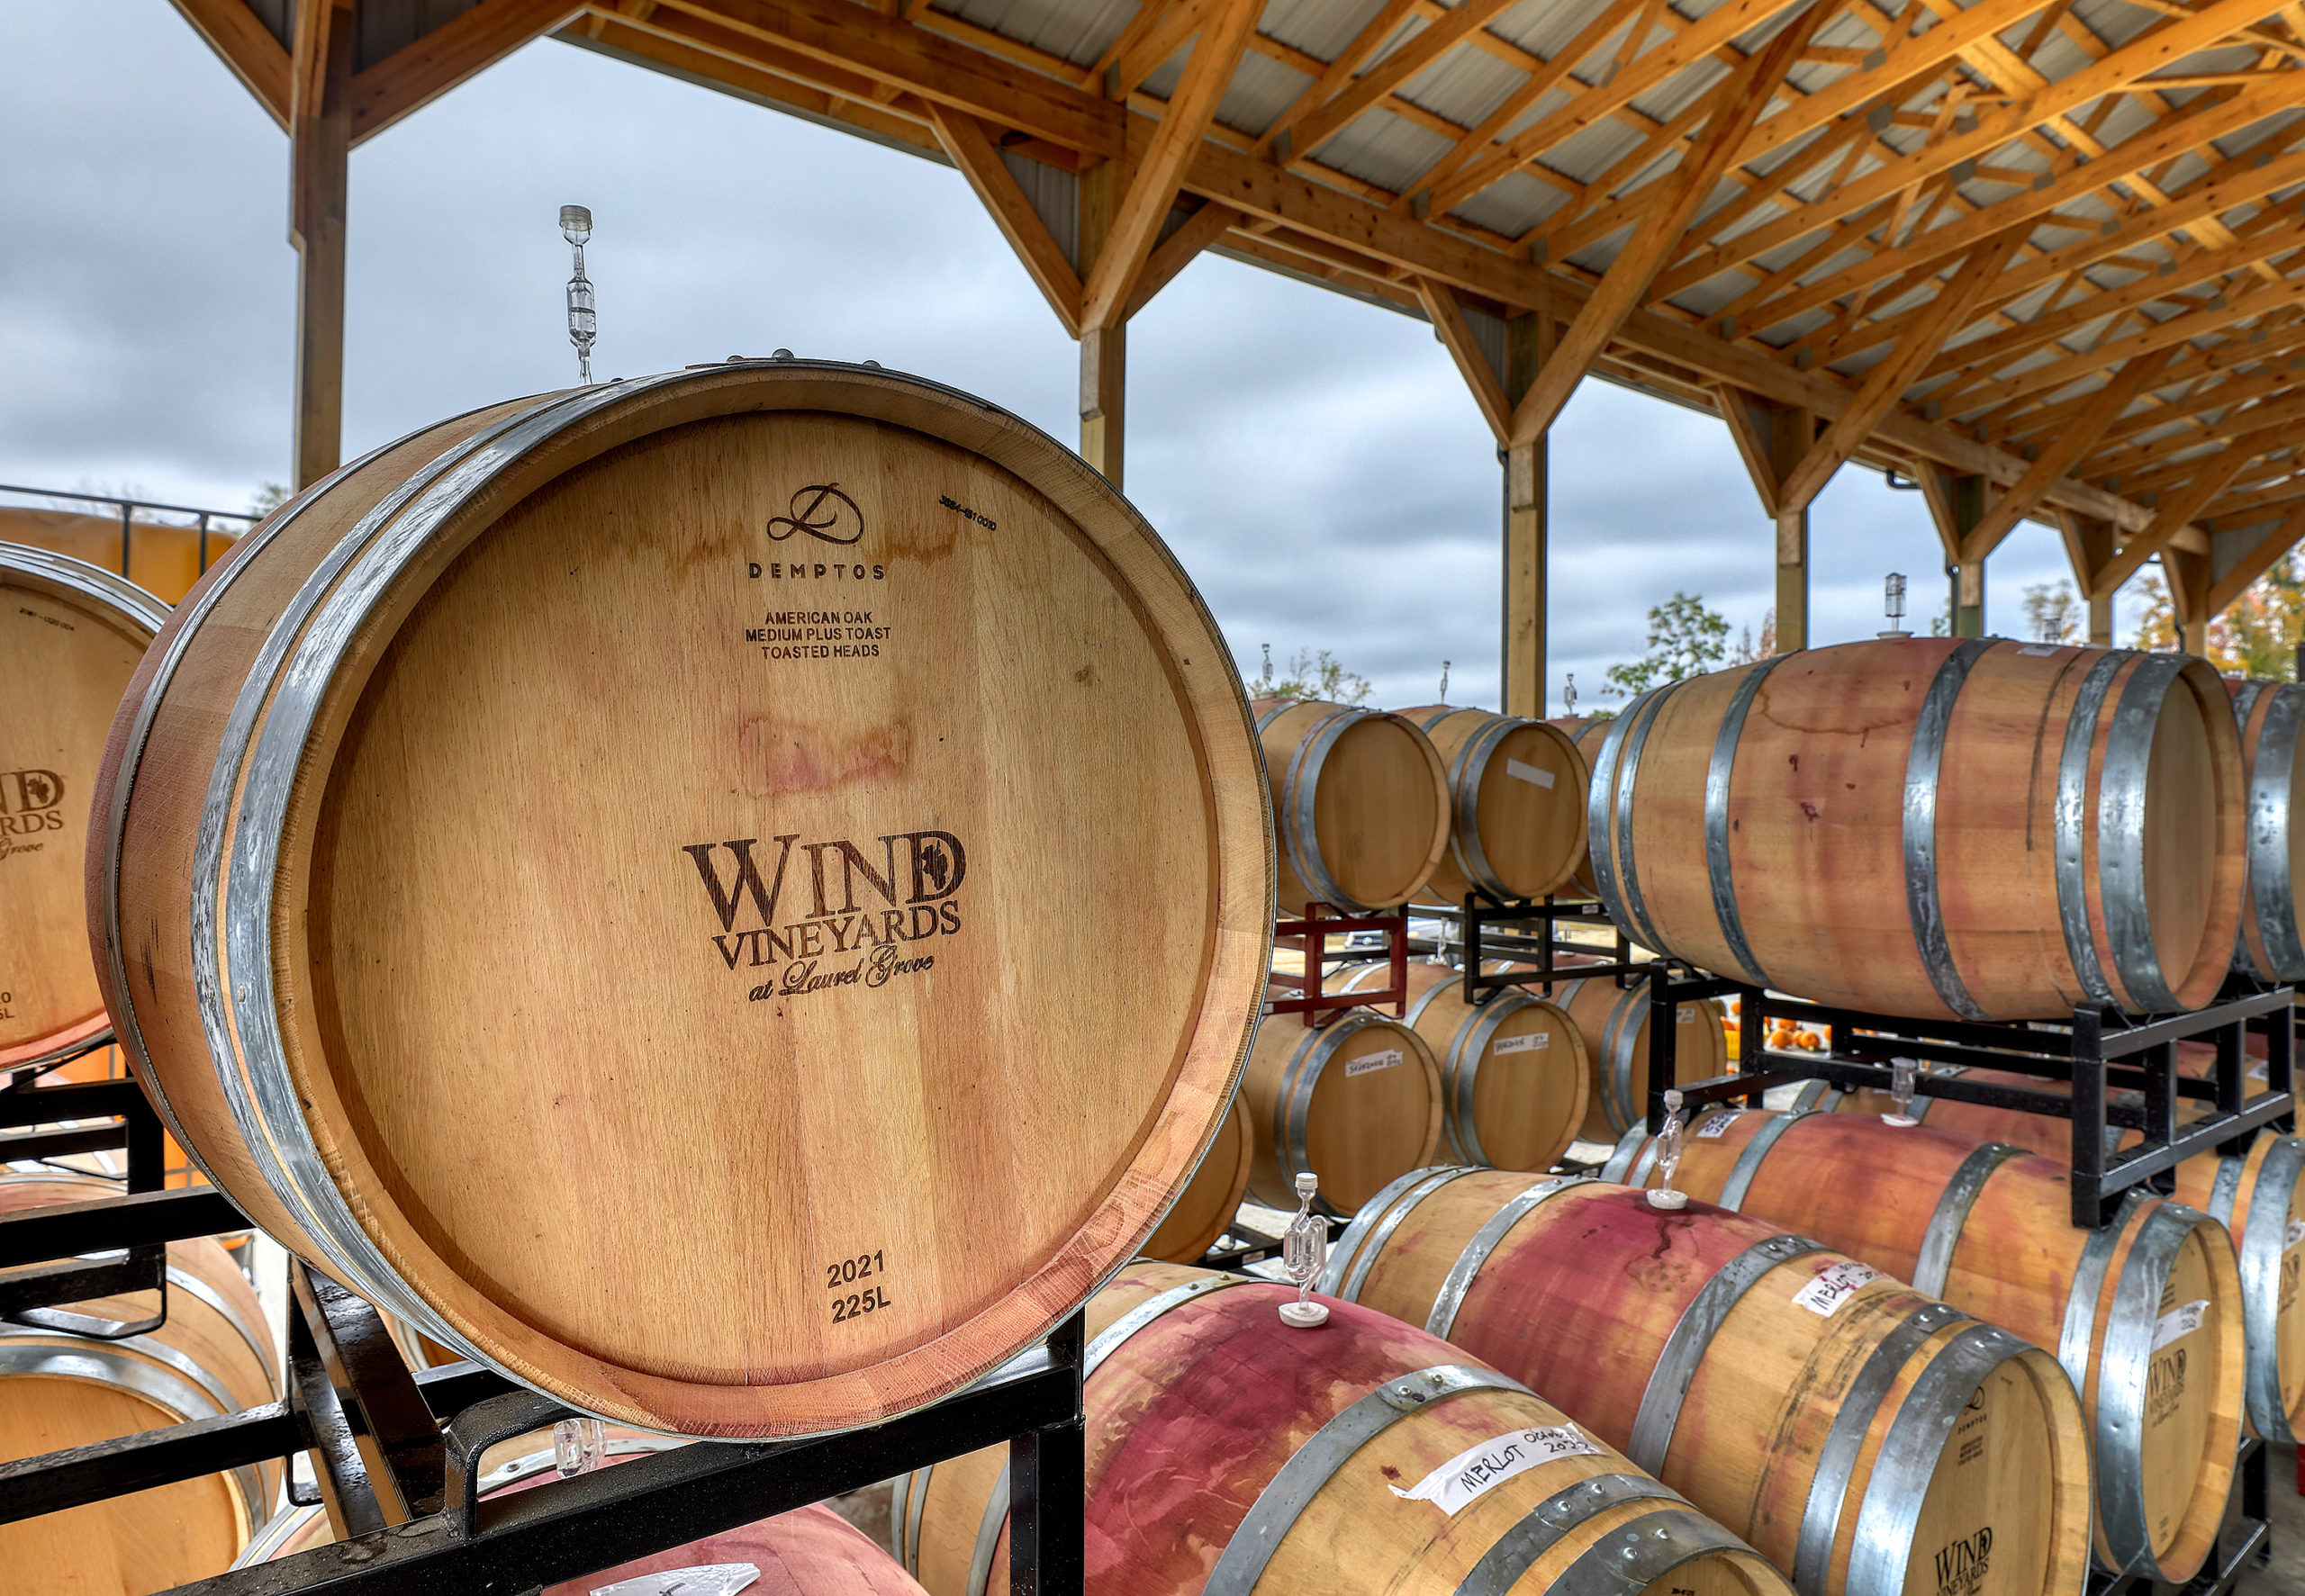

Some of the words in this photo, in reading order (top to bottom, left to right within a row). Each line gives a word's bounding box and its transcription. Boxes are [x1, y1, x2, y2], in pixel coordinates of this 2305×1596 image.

[748, 563, 884, 581] DEMPTOS
[746, 628, 802, 642] MEDIUM
[807, 627, 842, 641] PLUS
[845, 627, 890, 640] TOAST
[765, 611, 840, 625] AMERICAN
[844, 611, 872, 624] OAK
[762, 645, 829, 660] TOASTED
[834, 644, 880, 658] HEADS
[682, 830, 967, 933] WIND
[711, 900, 962, 970] VINEYARDS
[748, 979, 774, 1002] at
[778, 958, 864, 996] Laurel
[864, 944, 935, 988] Grove
[827, 1249, 883, 1289] 2021
[832, 1286, 890, 1324] 225L
[1460, 1444, 1525, 1493] MERLOT
[1935, 1527, 1993, 1591] WIND
